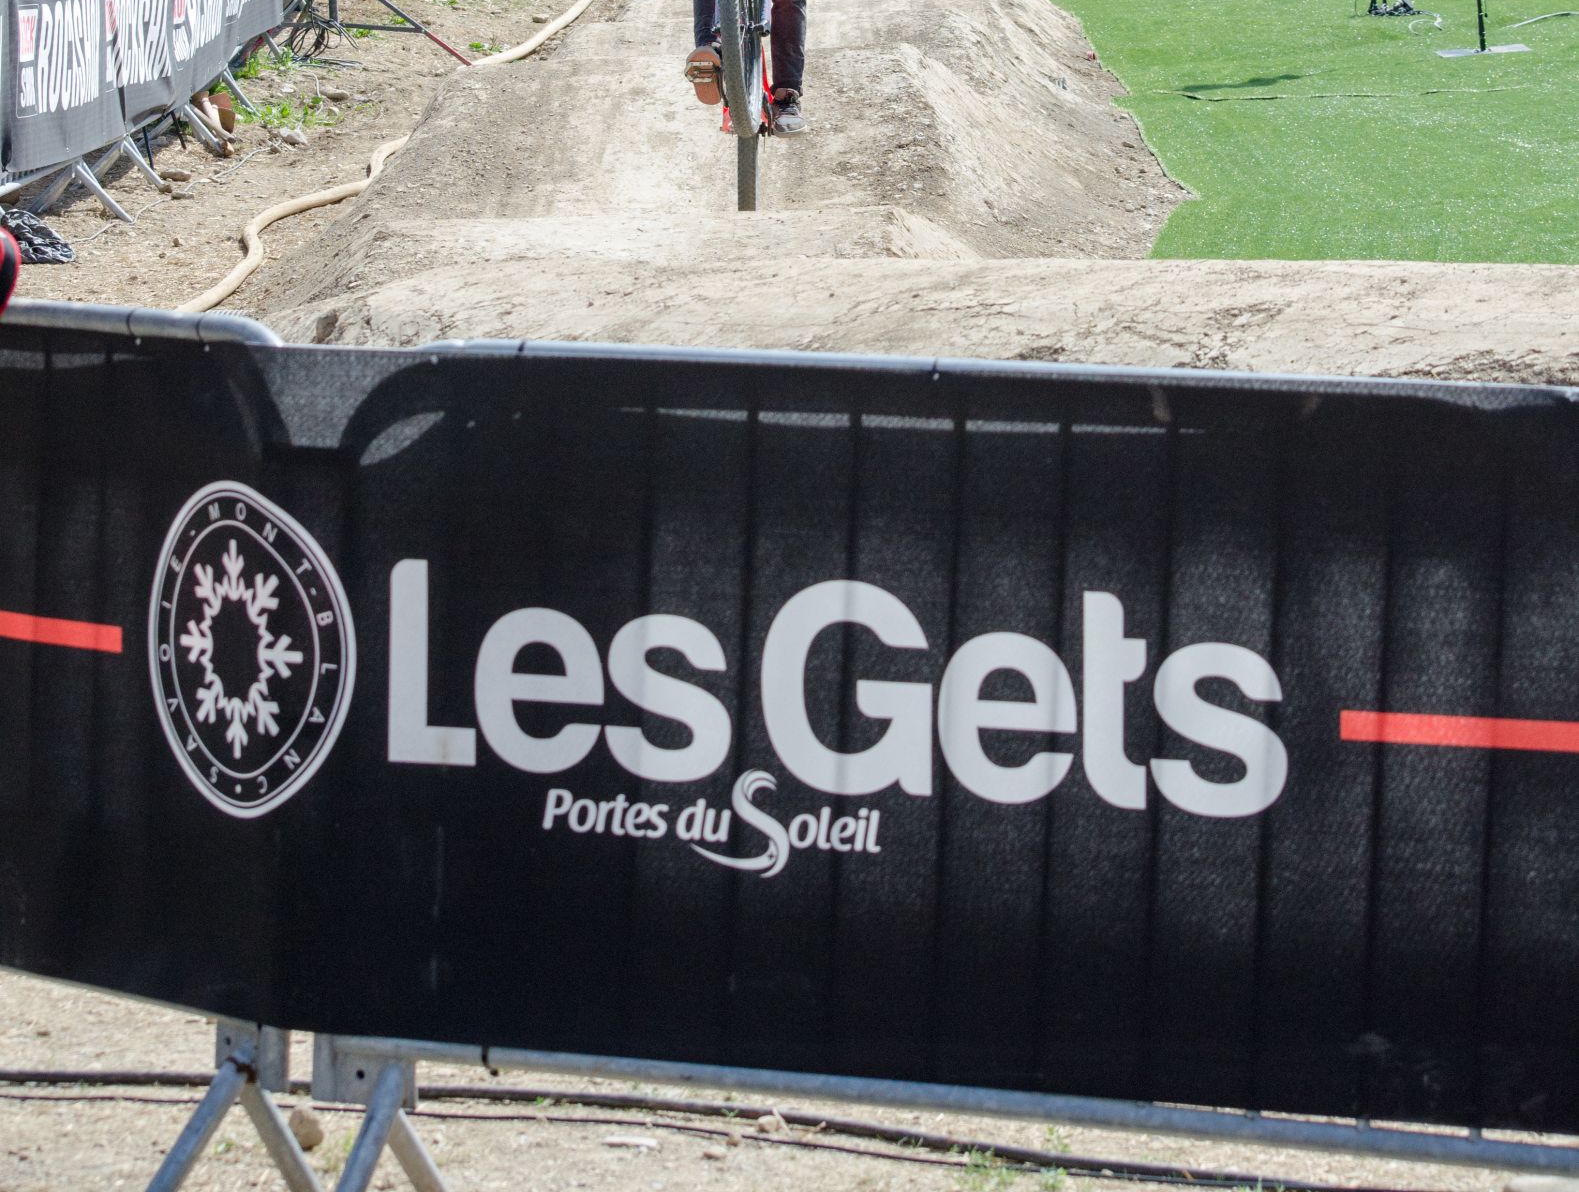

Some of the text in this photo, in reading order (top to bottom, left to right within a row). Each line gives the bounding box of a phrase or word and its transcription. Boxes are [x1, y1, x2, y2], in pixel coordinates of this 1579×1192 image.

[388, 558, 1289, 818] Les Gets
[542, 768, 882, 879] Portes du Soleil
